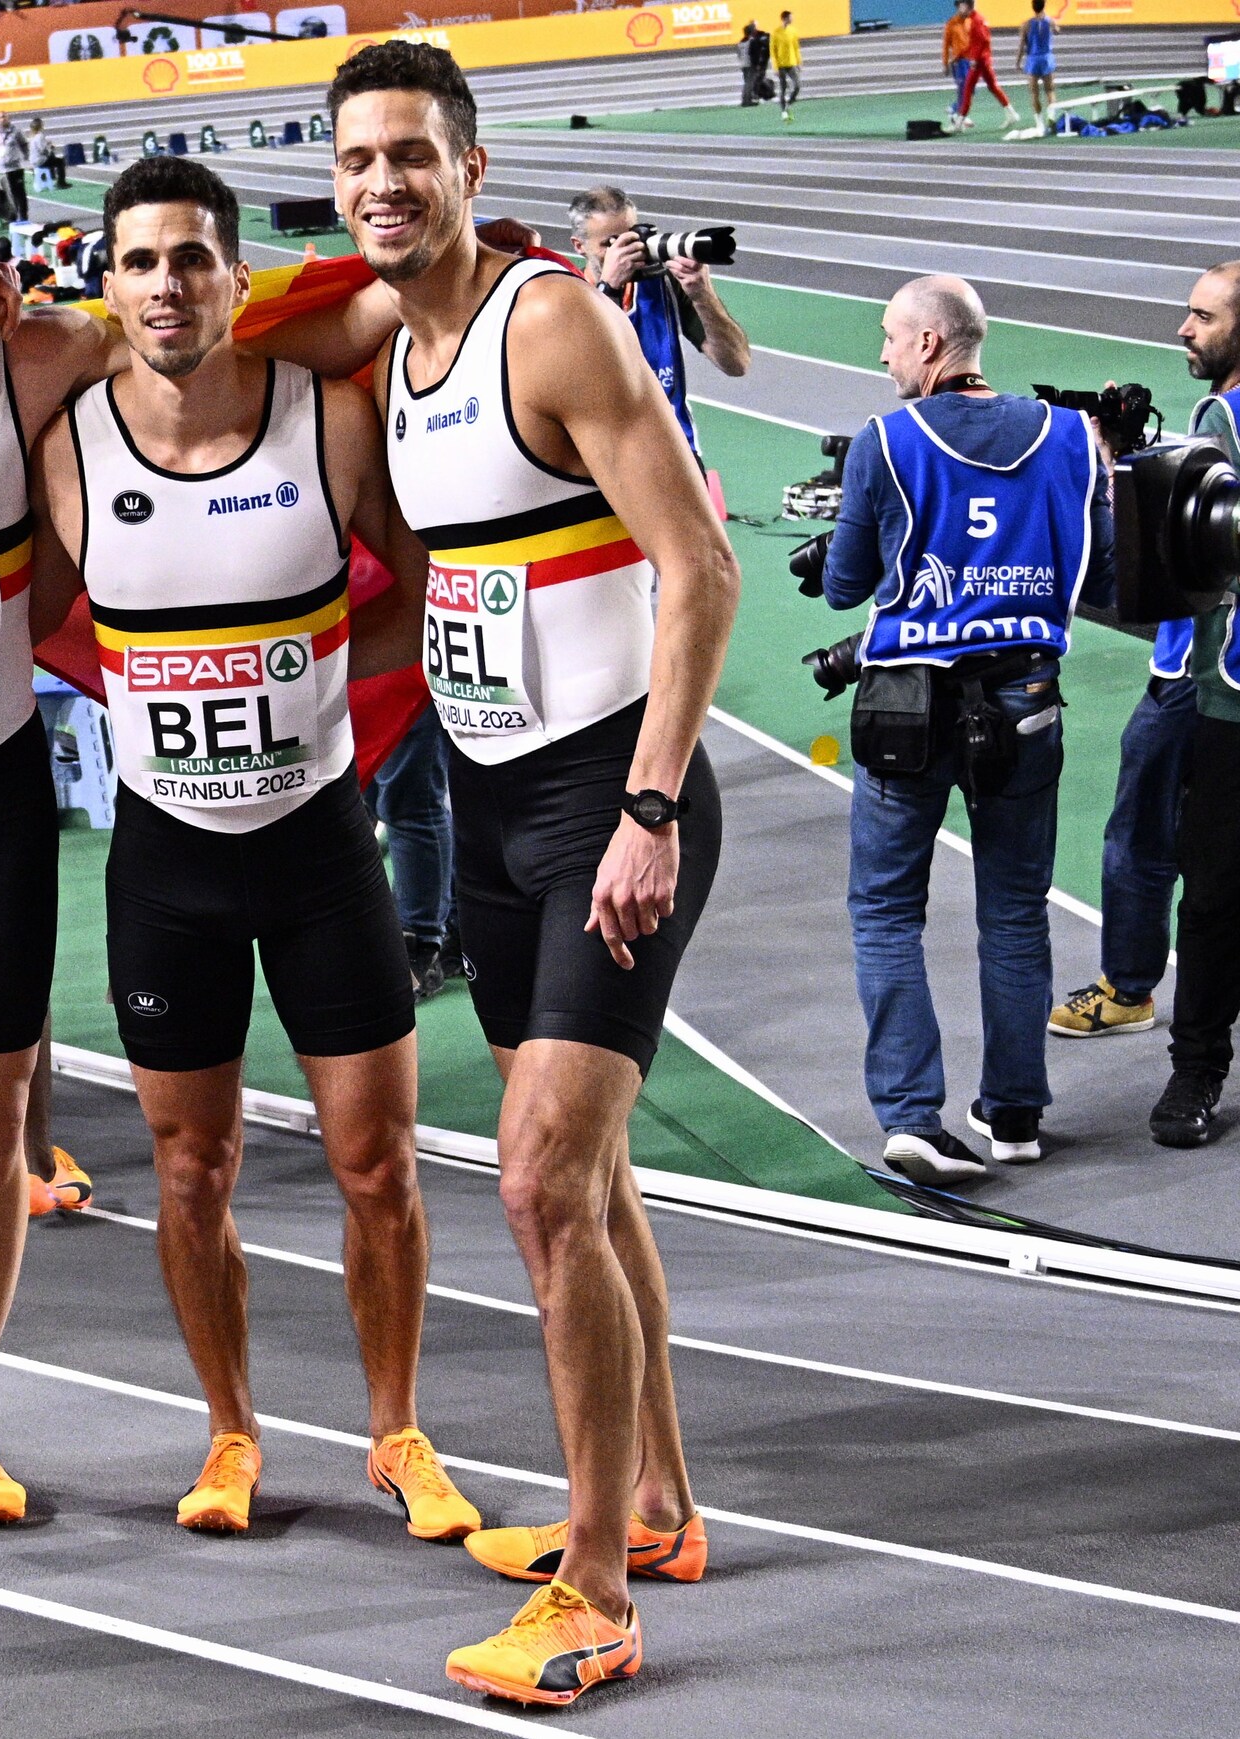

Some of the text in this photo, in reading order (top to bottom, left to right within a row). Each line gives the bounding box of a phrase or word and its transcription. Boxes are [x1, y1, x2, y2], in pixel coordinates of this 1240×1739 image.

[426, 409, 462, 433] Allianz
[118, 509, 148, 518] vermarc
[207, 493, 273, 515] Allianz
[966, 498, 998, 539] 5
[963, 565, 1055, 581] EUROPEAN
[427, 567, 476, 607] PAR
[961, 580, 1055, 597] ATHLETICS
[428, 613, 508, 688] BEL
[130, 653, 259, 686] SPAR
[436, 678, 452, 695] RUN
[146, 695, 300, 760] BEL
[479, 709, 527, 729] 2023
[170, 759, 175, 772] I
[178, 759, 214, 773] RUN
[153, 769, 306, 800] ISTANBUL 2023
[132, 1004, 162, 1012] vermarc
